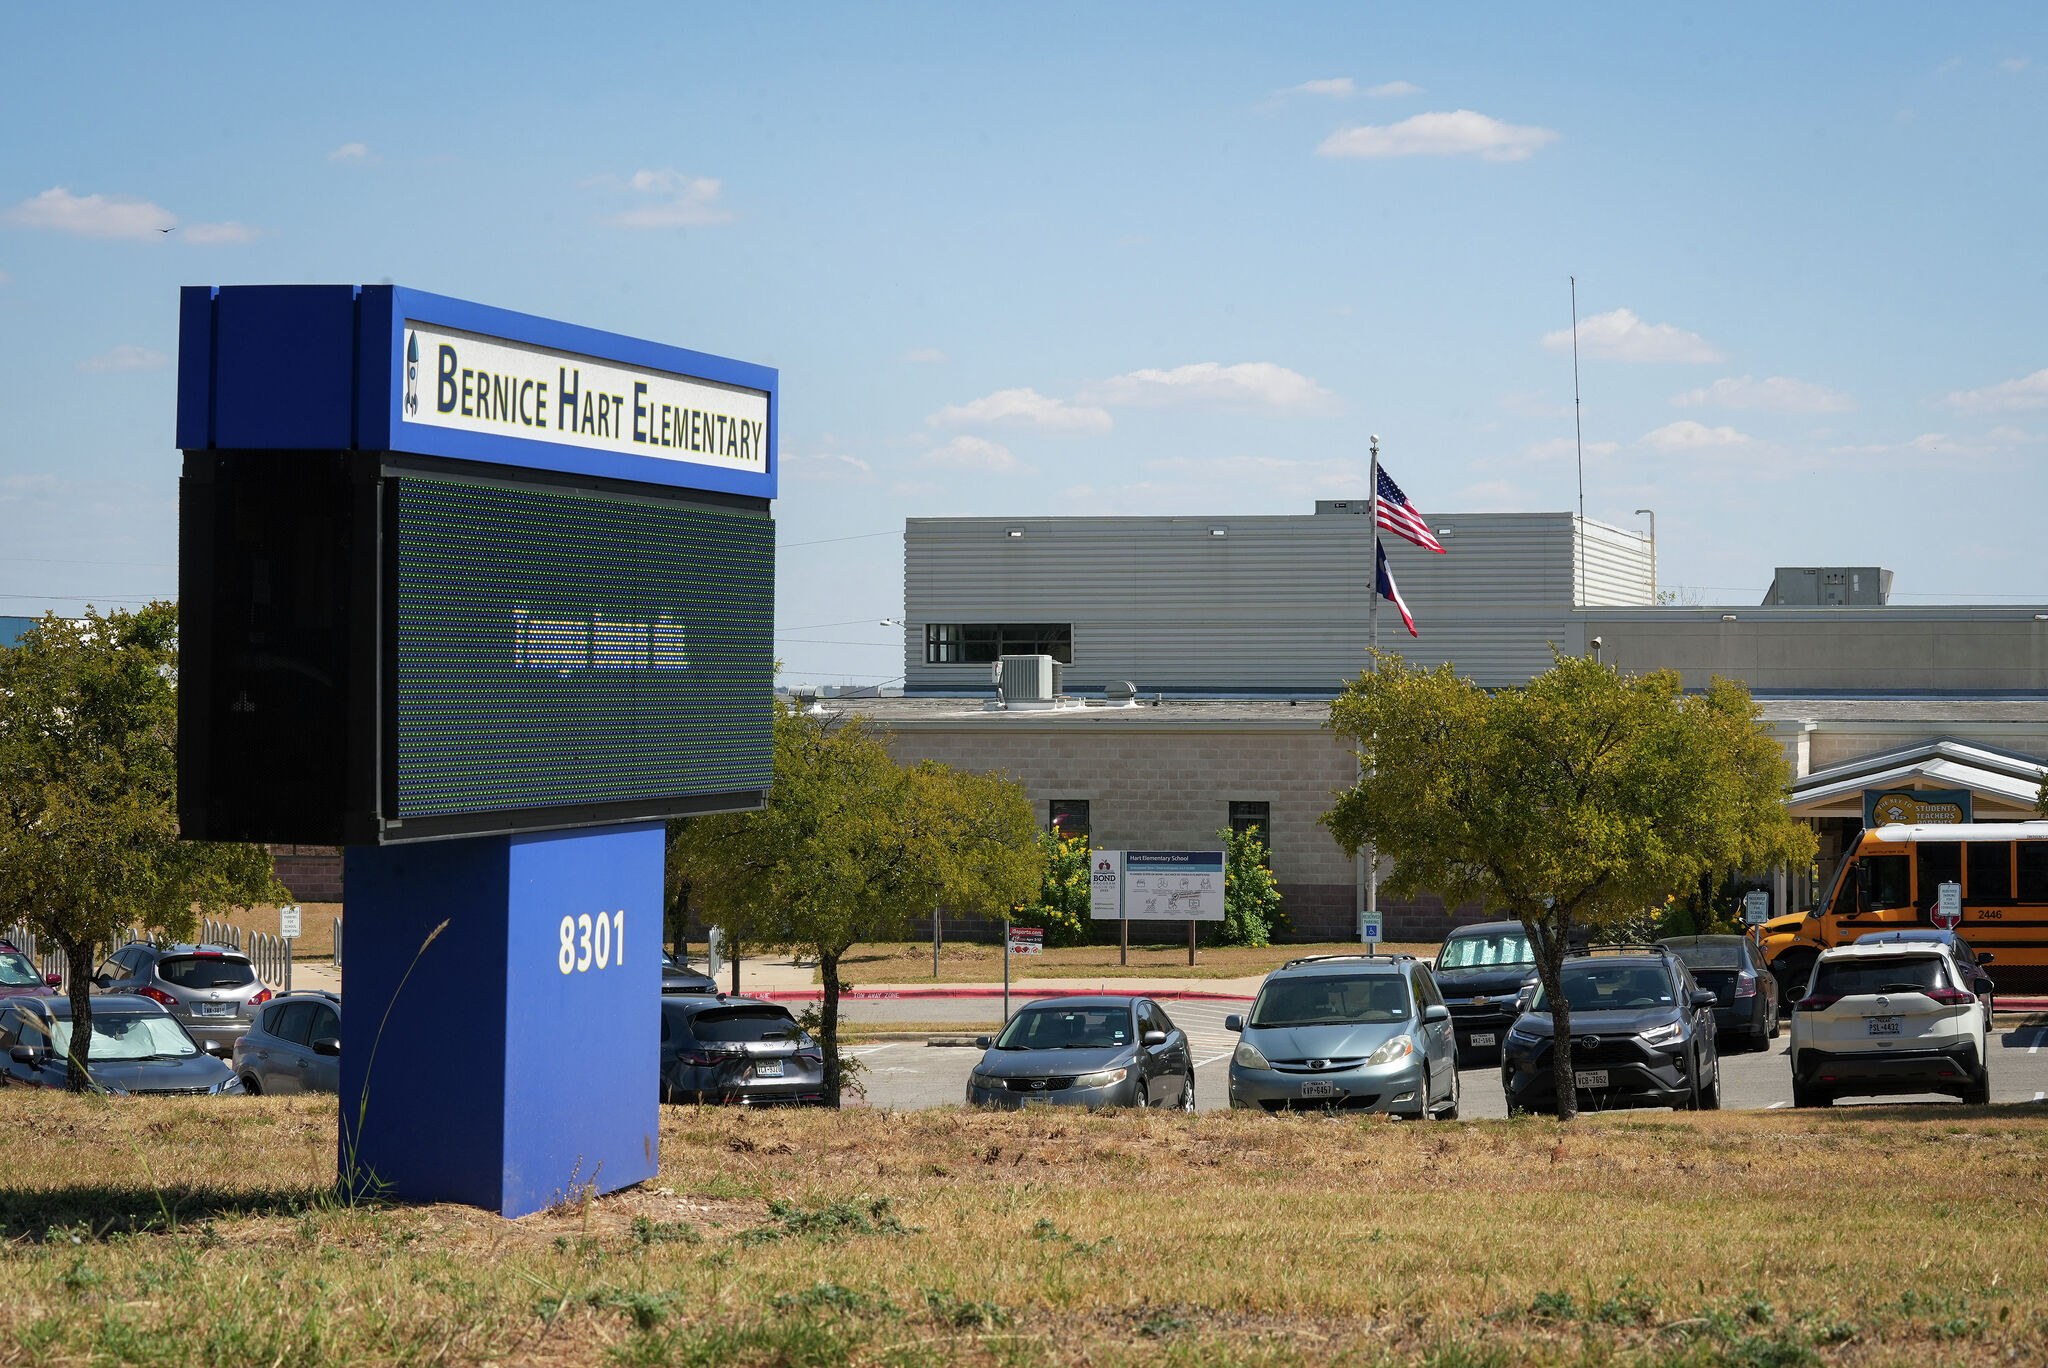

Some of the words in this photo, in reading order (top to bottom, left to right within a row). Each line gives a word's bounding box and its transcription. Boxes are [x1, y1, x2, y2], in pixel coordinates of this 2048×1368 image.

[437, 343, 548, 428] BERNICE
[558, 366, 624, 440] HART
[632, 381, 763, 461] ELEMENTARY
[1878, 801, 1888, 809] THE
[1978, 910, 2002, 919] 2446
[559, 910, 624, 975] 8301
